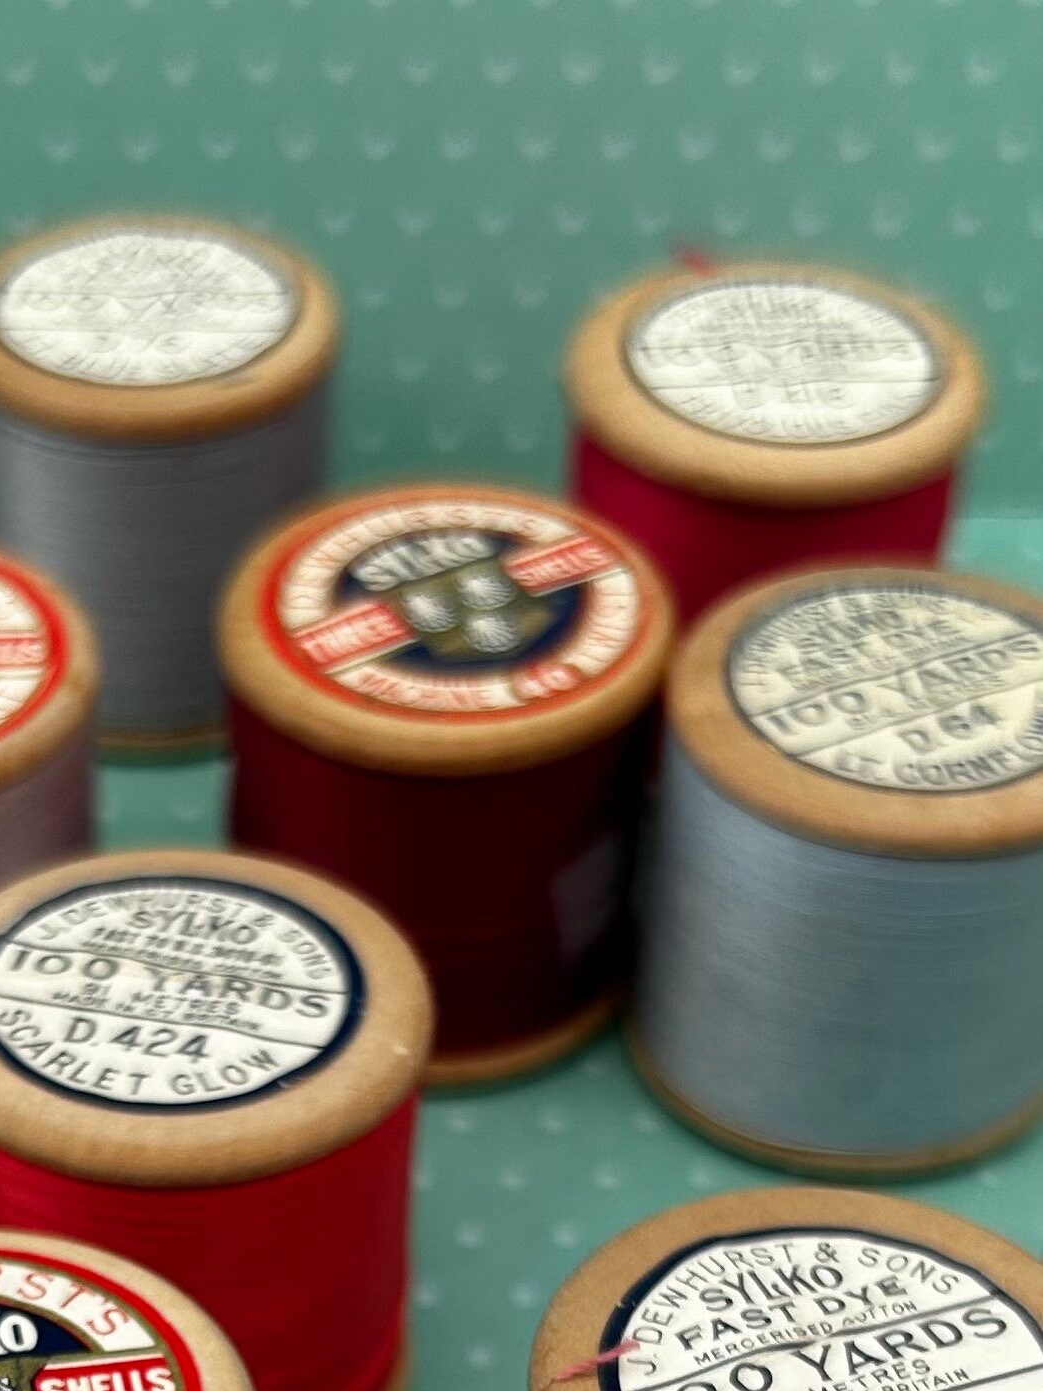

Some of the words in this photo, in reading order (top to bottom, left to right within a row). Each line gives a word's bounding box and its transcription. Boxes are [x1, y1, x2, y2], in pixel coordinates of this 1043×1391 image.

[767, 691, 868, 735] 100
[877, 639, 1042, 702] YARDS
[126, 909, 258, 946] SYLKO
[9, 950, 120, 981] 100
[143, 966, 330, 1019] YARDS
[63, 1017, 210, 1063] D.424
[169, 1048, 281, 1096] GLOW
[632, 1243, 798, 1346] DEWHURST
[814, 1241, 842, 1265] &
[858, 1246, 960, 1296] SONS
[674, 1300, 797, 1351] FAST
[813, 1275, 908, 1316] DYE
[698, 1263, 843, 1313] SYLKO
[792, 1306, 1009, 1383] YARDS
